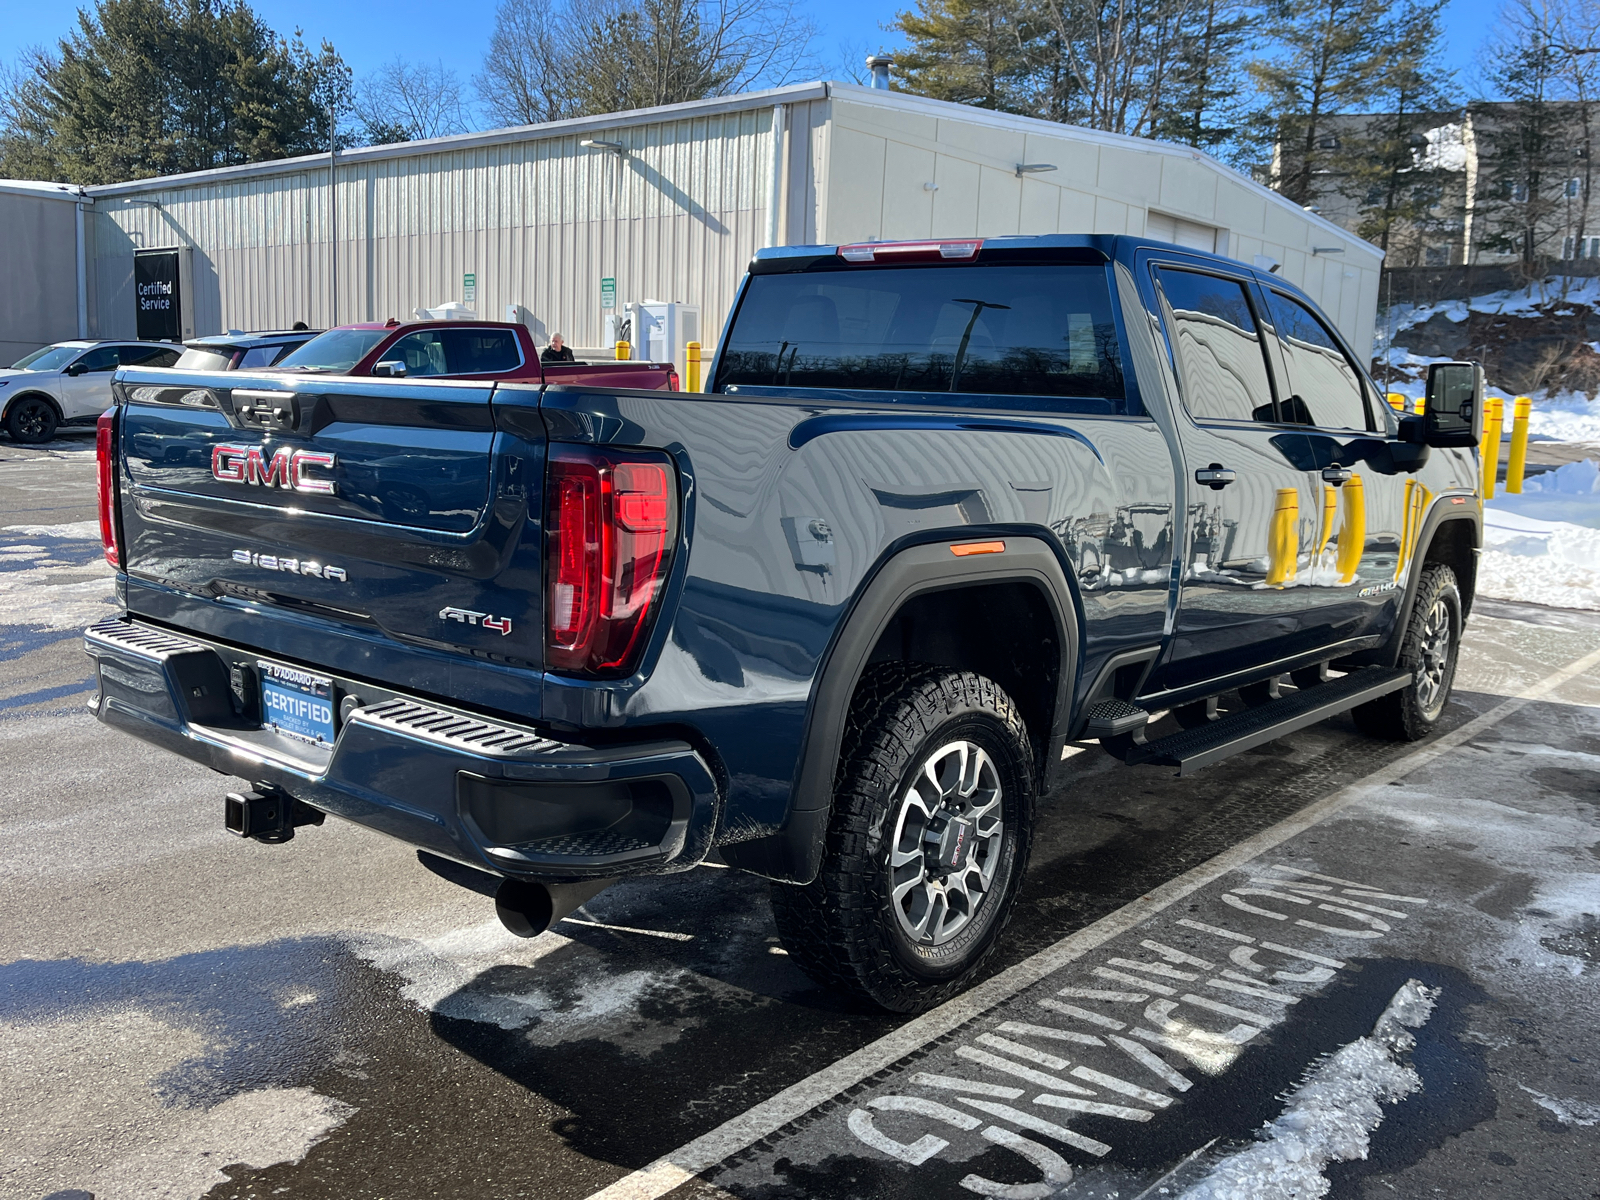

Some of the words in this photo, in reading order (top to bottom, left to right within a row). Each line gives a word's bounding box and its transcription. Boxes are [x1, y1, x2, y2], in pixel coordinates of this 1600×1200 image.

[138, 281, 172, 295] Certified
[141, 297, 170, 310] Service
[211, 443, 340, 496] GMC
[231, 549, 347, 582] SIERRA
[1381, 582, 1398, 592] HD
[438, 606, 512, 636] AT4
[273, 667, 311, 686] D'ADDARIO
[263, 689, 332, 724] CERTIFIED
[283, 714, 302, 725] BACKED
[269, 716, 294, 729] CHEVROLET
[295, 724, 310, 734] BUICK
[951, 823, 966, 867] GMC
[1222, 865, 1429, 941] NO
[846, 919, 1347, 1200] PARKING
